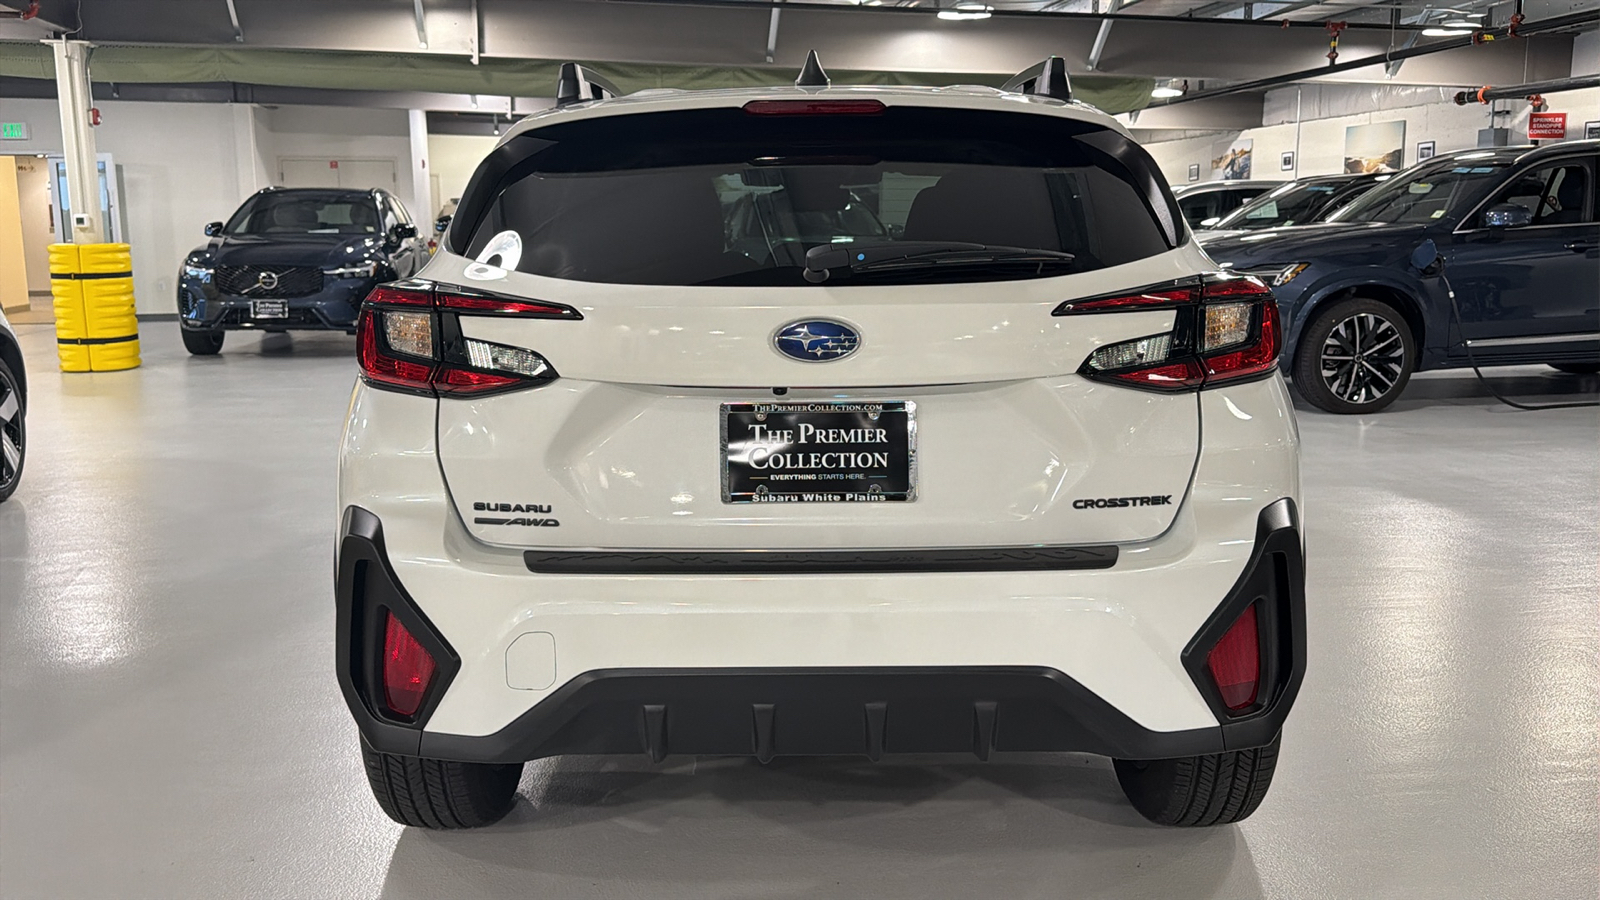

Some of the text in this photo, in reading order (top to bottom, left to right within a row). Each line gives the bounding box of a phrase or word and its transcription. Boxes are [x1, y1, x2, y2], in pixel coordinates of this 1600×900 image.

[747, 423, 889, 444] THE PREMIER
[748, 447, 889, 469] COLLECTION
[752, 493, 887, 502] Subaru White Plains
[1073, 495, 1172, 509] CROSSTREK
[473, 502, 552, 513] SUBARU
[505, 518, 560, 527] AWD
